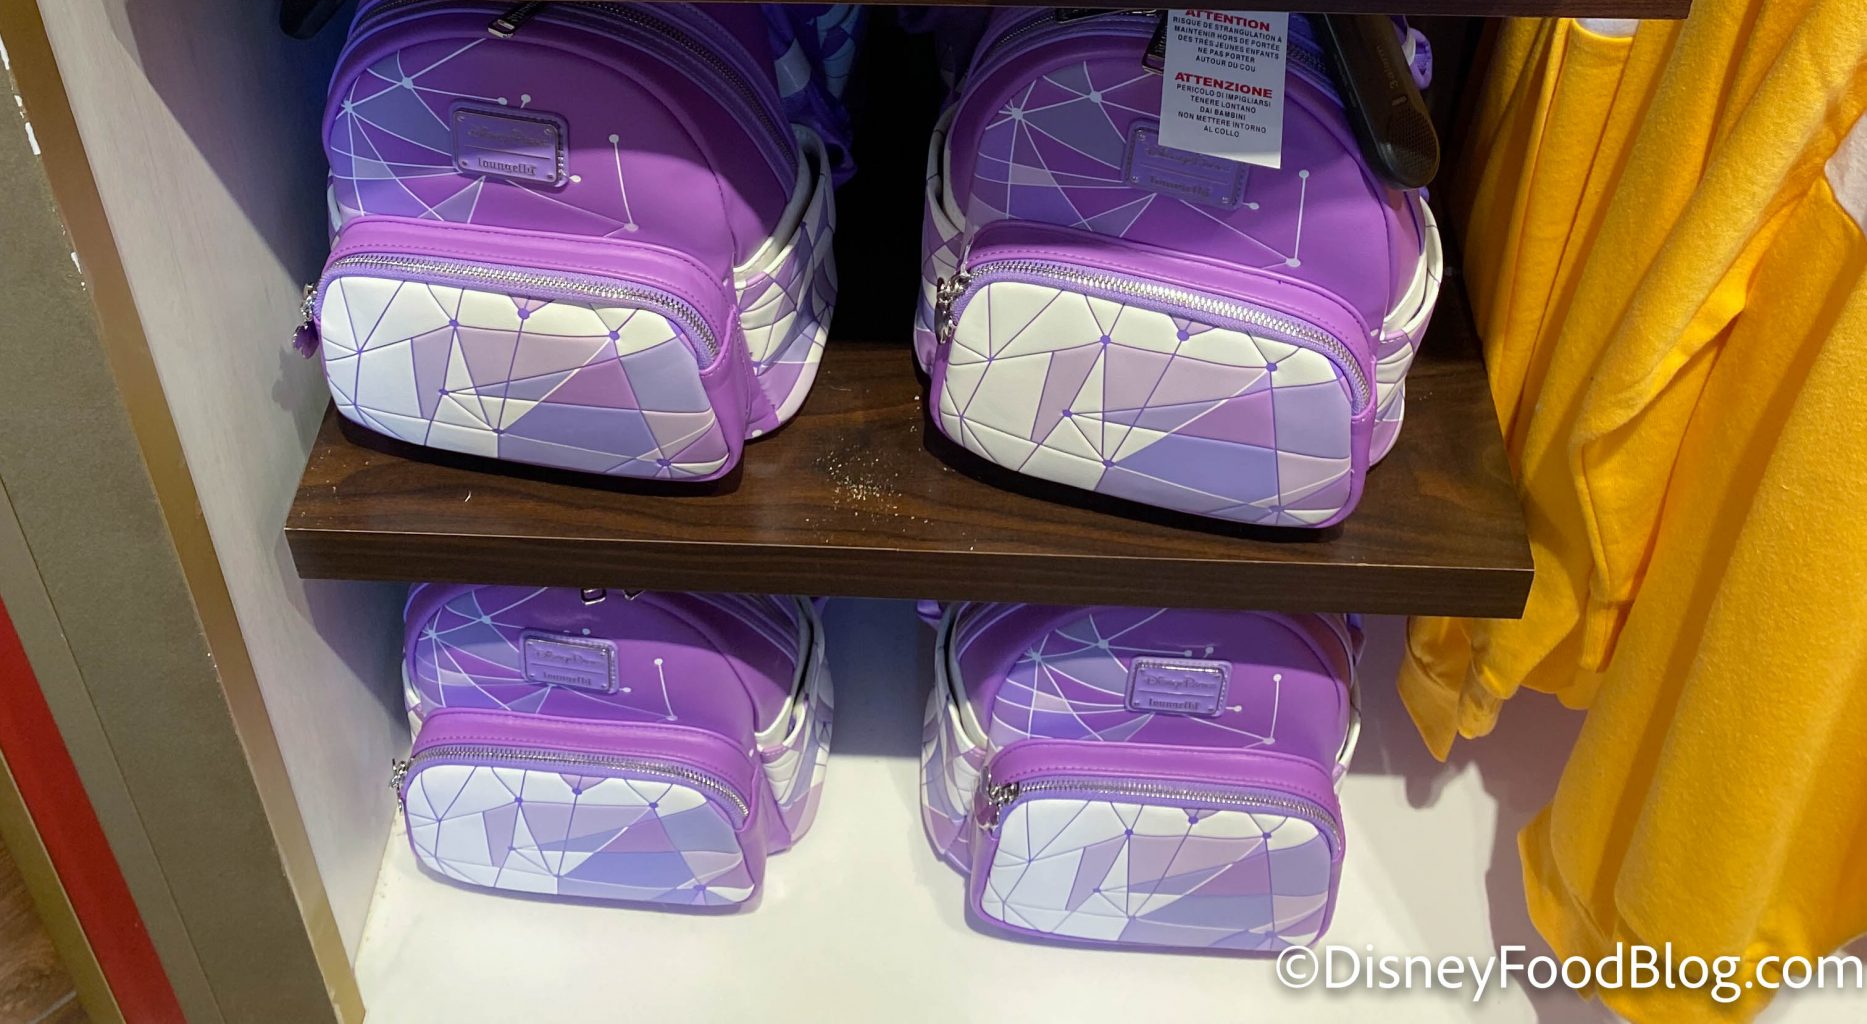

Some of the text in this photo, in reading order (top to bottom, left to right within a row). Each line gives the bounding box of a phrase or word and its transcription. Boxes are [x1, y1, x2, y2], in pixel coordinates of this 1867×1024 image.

[1173, 16, 1201, 26] RISQUE
[1214, 23, 1275, 41] STRANGULATION
[1174, 25, 1215, 38] MAINTENIR
[1217, 34, 1238, 43] HORS
[1178, 35, 1193, 43] DES
[1215, 40, 1244, 52] JEUNES
[1246, 45, 1279, 59] ENFANTS
[1210, 49, 1224, 57] PAS
[1226, 52, 1255, 63] PORTER
[1196, 56, 1226, 66] AUTOUR
[1240, 64, 1255, 72] COU
[1175, 72, 1273, 98] ATTENZIONE
[1177, 84, 1271, 107] PERICOLO DI IMPIGLIARSI
[1191, 96, 1256, 113] TENERE LONTANO
[1178, 111, 1266, 133] NON METTERE INTORNO
[1200, 106, 1245, 120] DAI BAMBINI
[1214, 127, 1239, 137] COLLO
